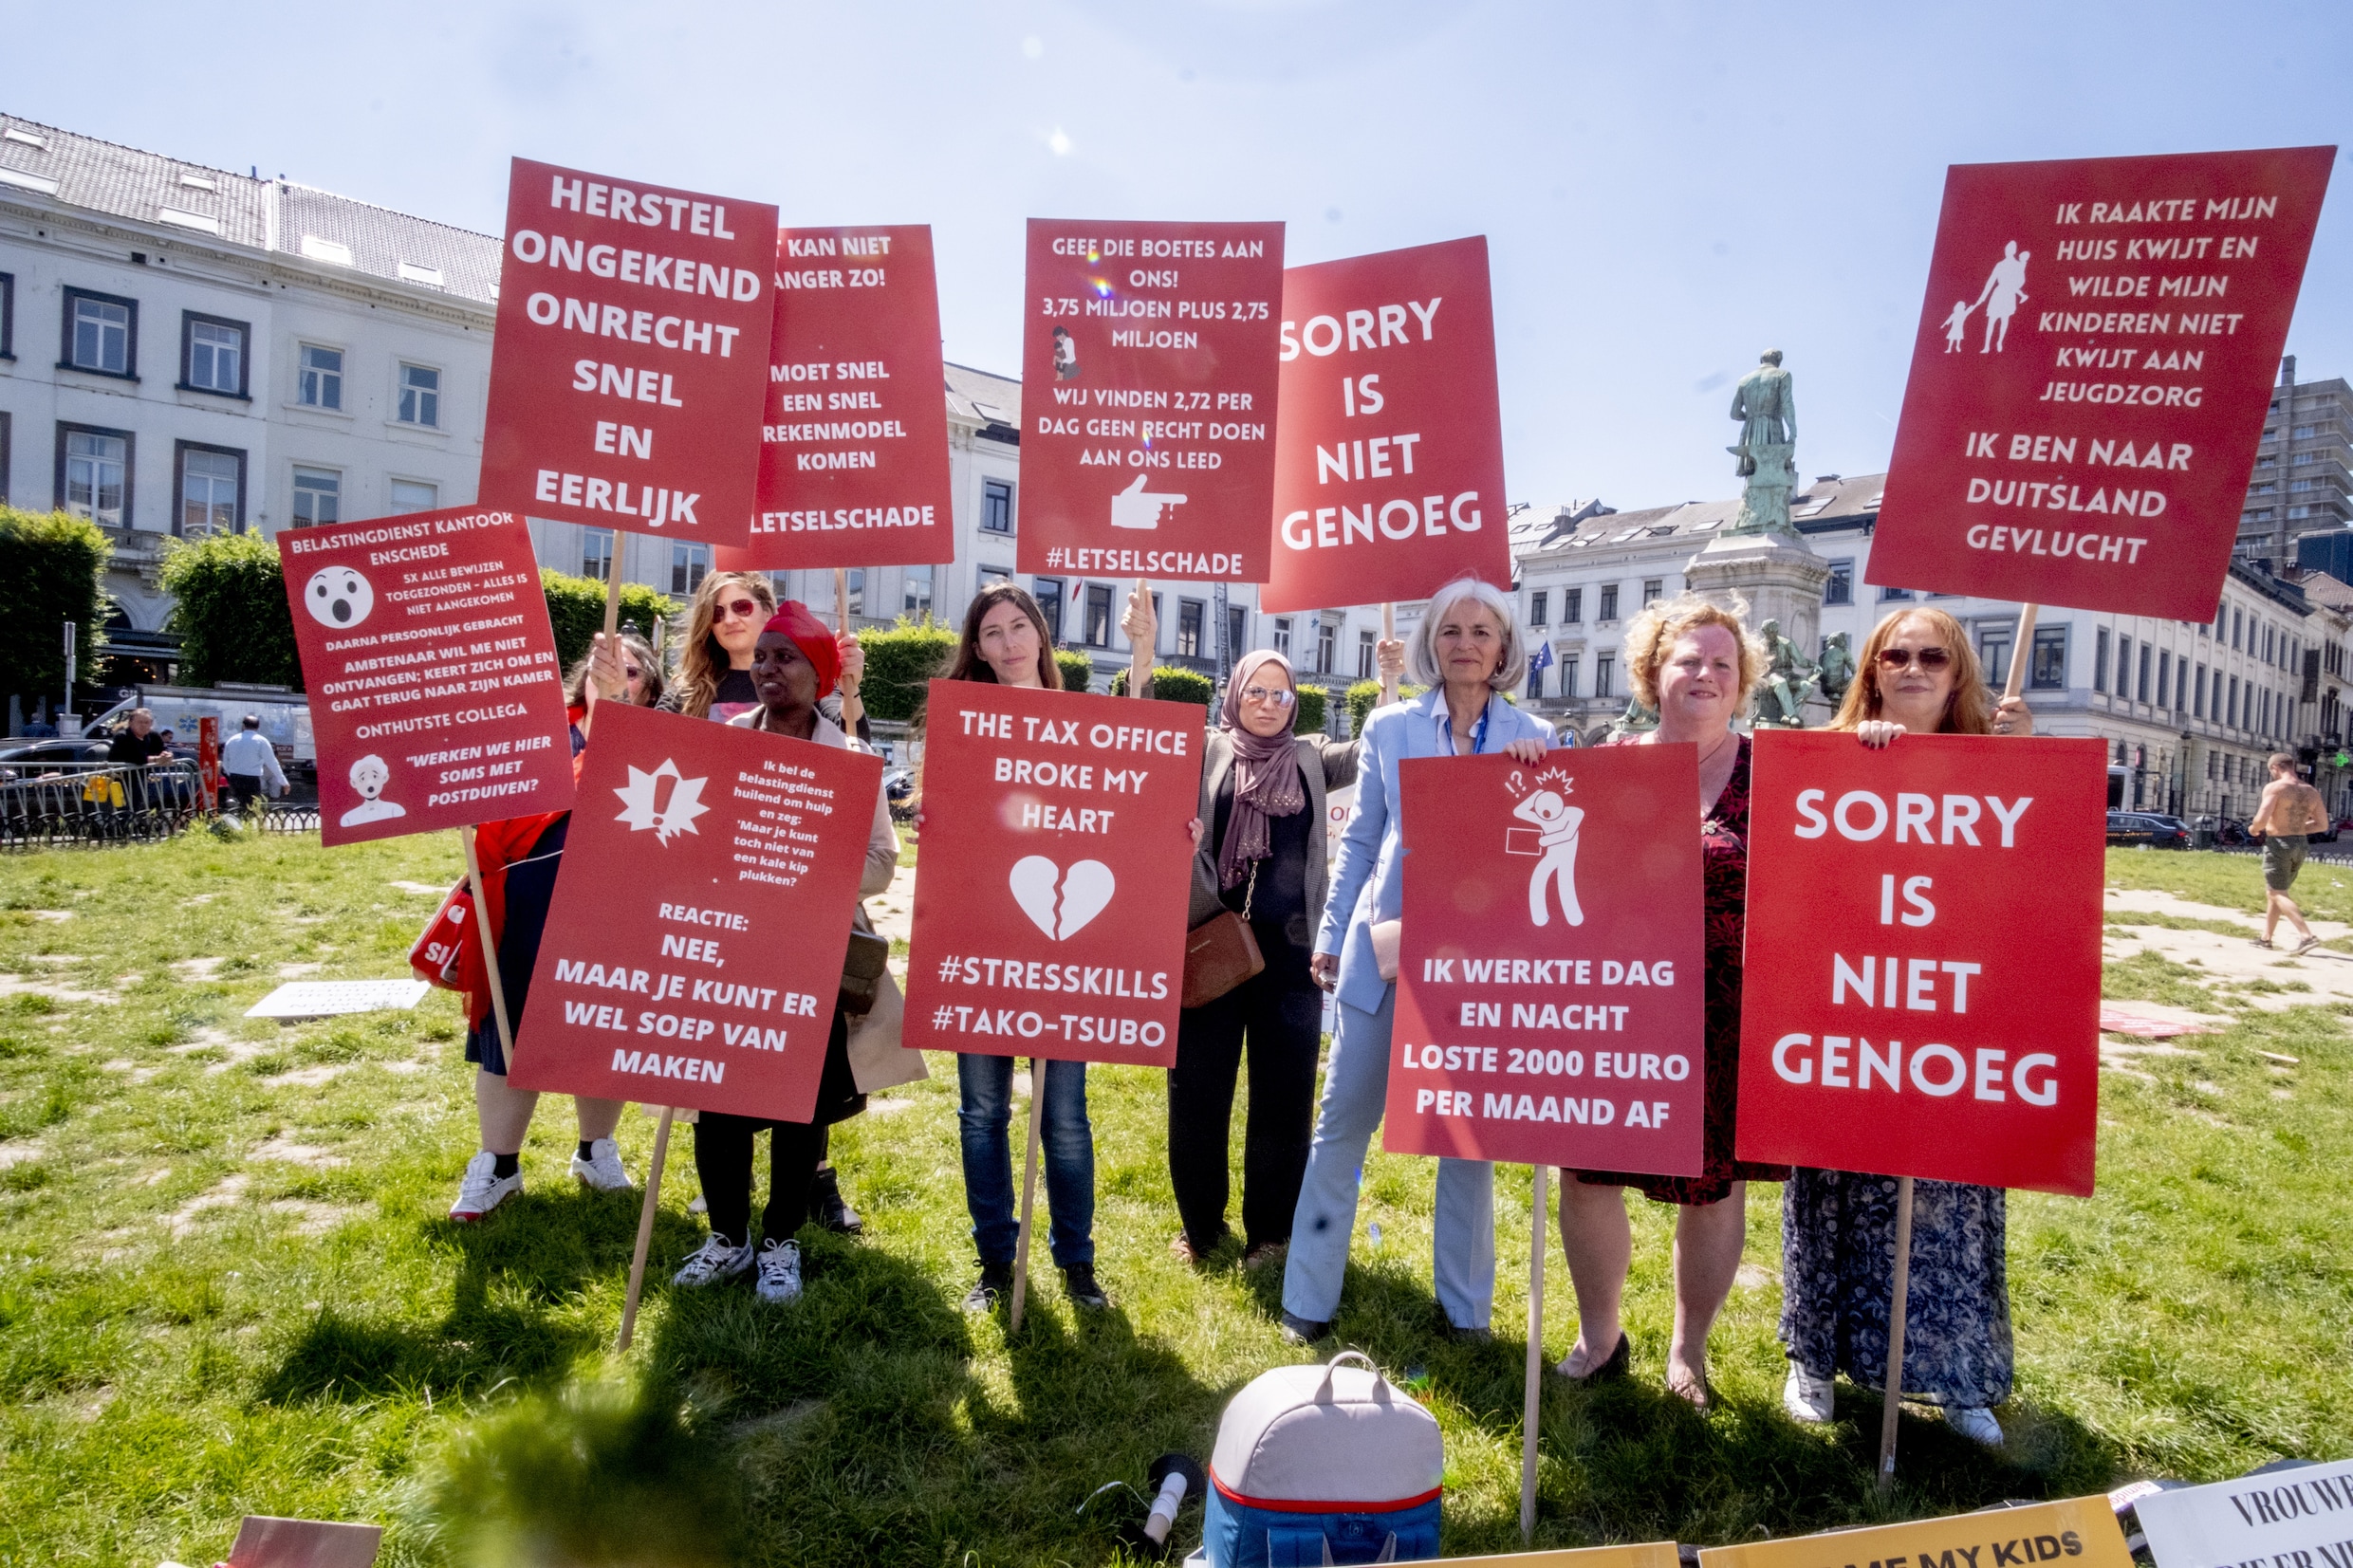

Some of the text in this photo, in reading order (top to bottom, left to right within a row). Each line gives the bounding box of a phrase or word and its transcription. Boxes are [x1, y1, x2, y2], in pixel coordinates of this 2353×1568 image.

[551, 175, 734, 240] HERSTEL
[2056, 196, 2277, 224] IK RAAKTE MIJN
[787, 238, 836, 257] KAN
[843, 236, 891, 255] NIET
[1052, 238, 1263, 258] GEEF DIE BOETES AAN
[2057, 237, 2258, 260] HUIS KWIJT EN
[512, 230, 760, 302] ONGEKEND
[848, 268, 885, 286] ZO!
[1130, 269, 1177, 287] ONS!
[2069, 276, 2228, 297] WILDE MIJN
[1043, 298, 1269, 322] 3,75 MILJOEN PLUS 2,75
[2039, 312, 2243, 334] KINDEREN NIET
[527, 292, 740, 358] ONRECHT
[1113, 330, 1197, 349] MILJOEN
[1279, 298, 1441, 361] SORRY
[770, 361, 890, 381] MOET SNEL
[2056, 347, 2204, 371] KWIJT AAN
[573, 360, 682, 407] SNEL
[1343, 374, 1383, 416] IS
[2040, 382, 2202, 407] JEUGDZORG
[784, 392, 881, 412] EEN SNEL
[1053, 388, 1252, 411] WIJ VINDEN 2,72 PER
[595, 421, 652, 459] EN
[763, 420, 906, 442] REKENMODEL
[1039, 417, 1265, 440] DAG GEEN RECHT DOEN
[797, 452, 876, 470] KOMEN
[1080, 449, 1221, 469] AAN ONS LEED
[1316, 434, 1420, 485] NIET
[1966, 433, 2193, 470] IK BEN NAAR
[536, 470, 700, 527] EERLIJK
[1967, 476, 2166, 517] DUITSLAND
[291, 512, 513, 554] BELASTINGDIENST KANTOOR
[1281, 490, 1482, 550] GENOEG
[370, 543, 449, 565] ENSCHEDE
[1967, 525, 2147, 563] GEVLUCHT
[403, 561, 504, 583] 5X ALLE BEWIJZEN
[1047, 547, 1242, 575] #LETSELSCHADE
[385, 581, 473, 607] TOEGEZONDEN
[484, 575, 514, 588] ALLES
[517, 574, 528, 583] IS
[407, 592, 514, 615] NIET AANGEKOMEN
[325, 615, 524, 651] DAARNA PERSOONLIJK GEBRACHT
[345, 637, 526, 673] AMBTENAAR WIL ME NIET
[424, 664, 467, 679] KEERT
[471, 658, 504, 673] ZICH
[508, 655, 531, 667] OM
[535, 652, 554, 663] EN
[331, 670, 553, 711] GAAT TERUG NAAR ZIJN KAMER
[356, 703, 528, 740] ONTHUTSTE COLLEGA
[959, 710, 1187, 756] THE TAX OFFICE
[486, 742, 510, 756] WE
[515, 736, 551, 752] HIER
[439, 761, 523, 784] SOMS MET
[764, 761, 815, 779] Ik bel de
[995, 758, 1148, 794] BROKE MY
[428, 779, 539, 806] POSTDUIVEN?
[738, 771, 834, 799] Belastingdienst
[733, 786, 832, 816] huilend om hulp
[759, 810, 802, 825] en zeg:
[1021, 802, 1115, 834] HEART
[1794, 788, 2033, 847] SORRY
[734, 836, 814, 858] toch niet van
[773, 826, 787, 839] je
[788, 829, 818, 843] kunt
[733, 854, 808, 875] een kale kip
[739, 870, 797, 886] plukken?
[1881, 875, 1936, 927] IS
[659, 903, 749, 932] REACTIE:
[661, 934, 724, 968] NEE,
[938, 955, 1168, 1000] #STRESSKILLS
[1424, 959, 1674, 986] IK WERKTE DAG
[1832, 952, 1981, 1013] NIET
[555, 959, 817, 1017] MAAR JE KUNT ER
[565, 1001, 787, 1052] WEL SOEP VAN
[932, 1005, 1165, 1047] #TAKO-TSUBO
[1460, 1003, 1629, 1031] EN NACHT
[611, 1049, 725, 1083] MAKEN
[1403, 1043, 1689, 1080] LOSTE 2000 EURO
[1771, 1033, 2057, 1106] GENOEG
[1417, 1089, 1669, 1128] PER MAAND AF
[1918, 1530, 2084, 1568] MY KIDS
